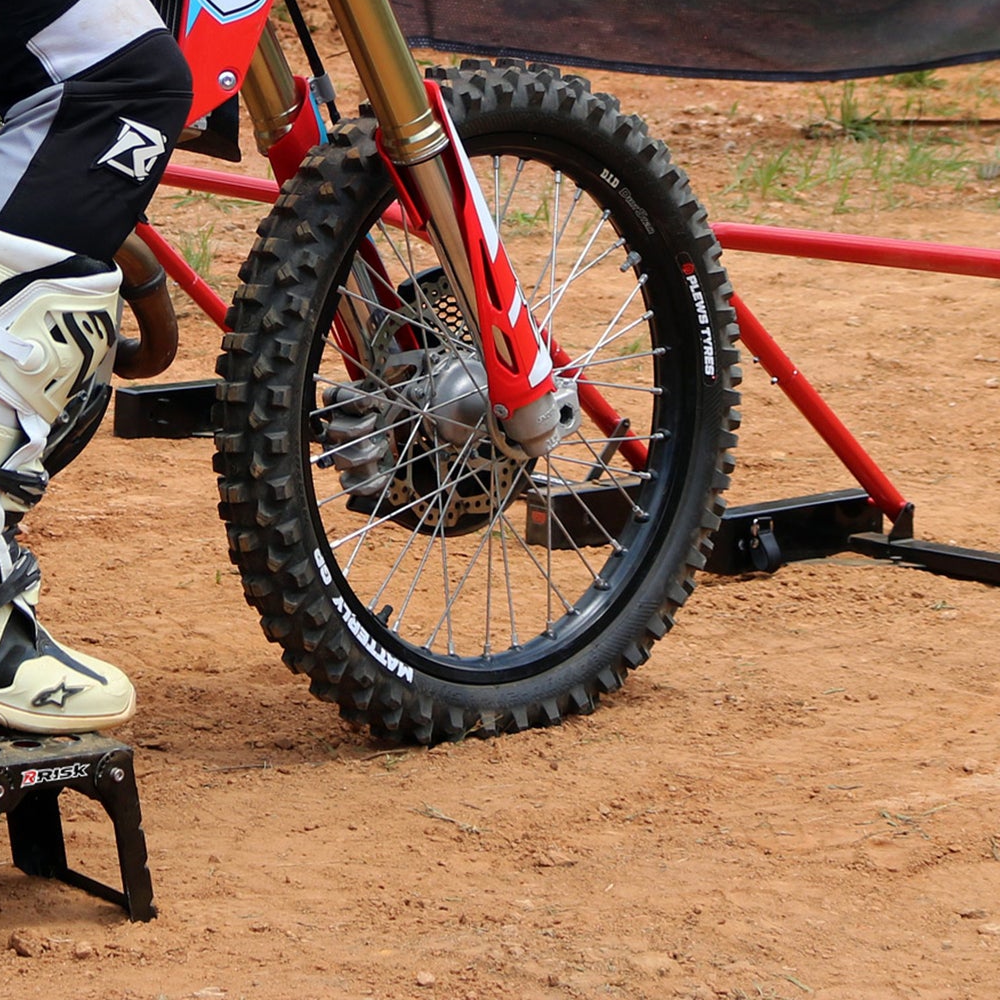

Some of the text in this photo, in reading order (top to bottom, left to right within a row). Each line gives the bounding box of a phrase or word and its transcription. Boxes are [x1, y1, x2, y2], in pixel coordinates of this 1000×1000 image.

[686, 274, 714, 376] PLEWS TYRES
[331, 595, 415, 684] MATTERLY
[35, 762, 91, 784] RISK
